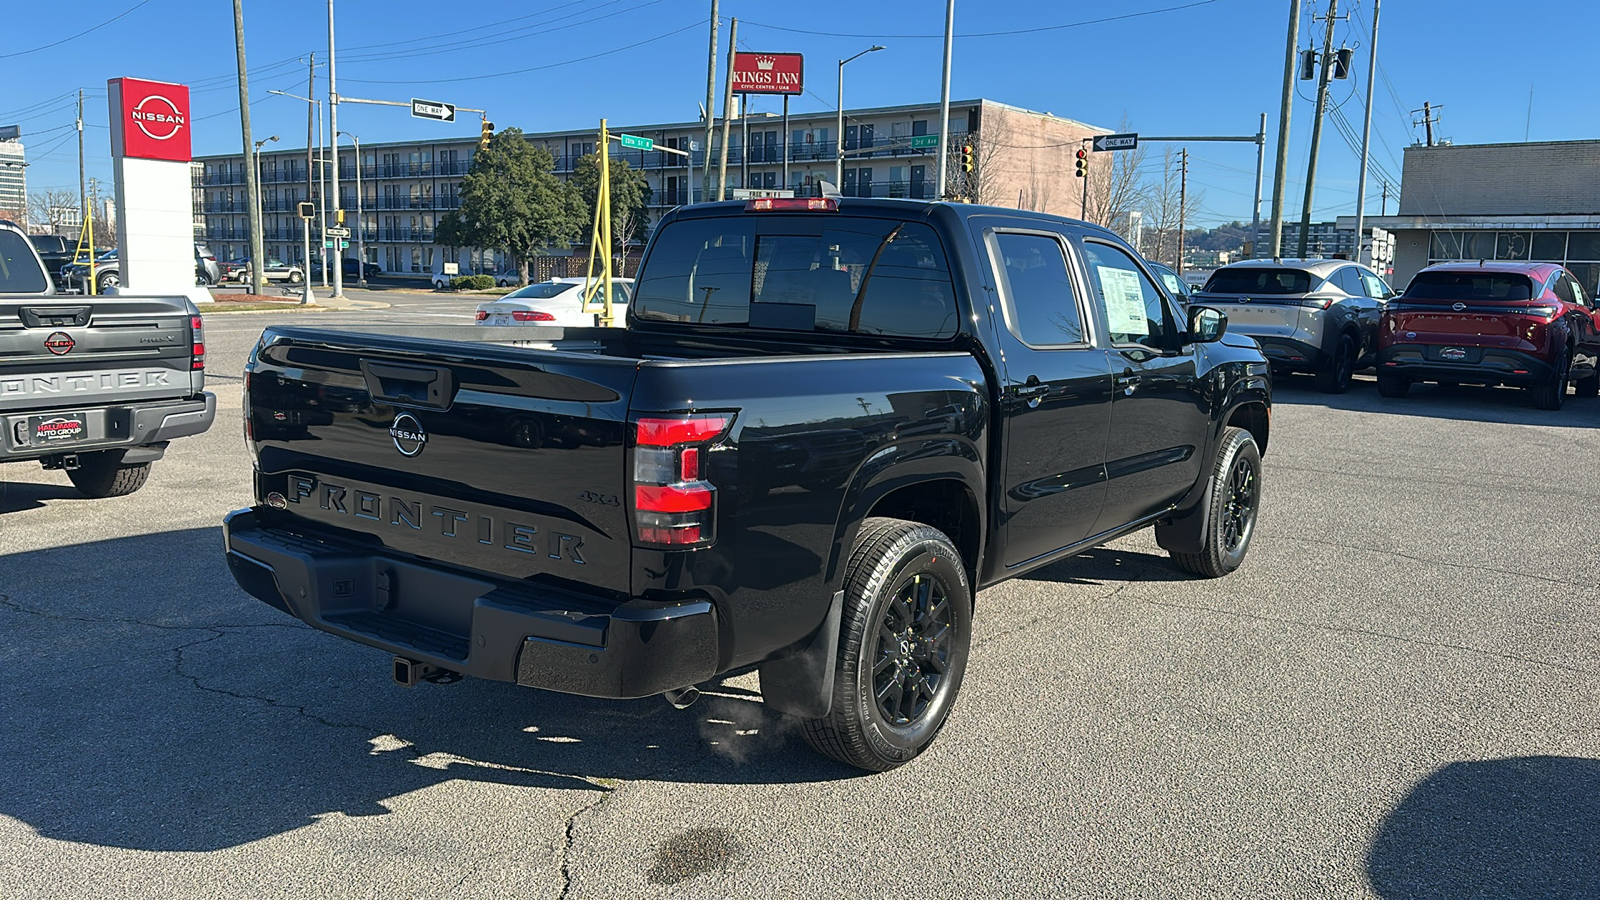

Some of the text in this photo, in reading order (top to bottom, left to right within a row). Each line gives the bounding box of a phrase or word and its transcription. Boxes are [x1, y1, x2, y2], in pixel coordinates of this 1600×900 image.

[733, 71, 799, 84] KINGS INN
[416, 104, 443, 115] ONE WAY
[132, 111, 184, 124] NISSAN
[36, 430, 56, 438] AUTO
[57, 427, 82, 436] GROUP
[38, 422, 79, 432] HALLMARK
[389, 428, 426, 442] NISSAN
[576, 490, 621, 508] 4X4
[286, 474, 587, 565] FRONTIER
[862, 683, 871, 721] PRIMACY
